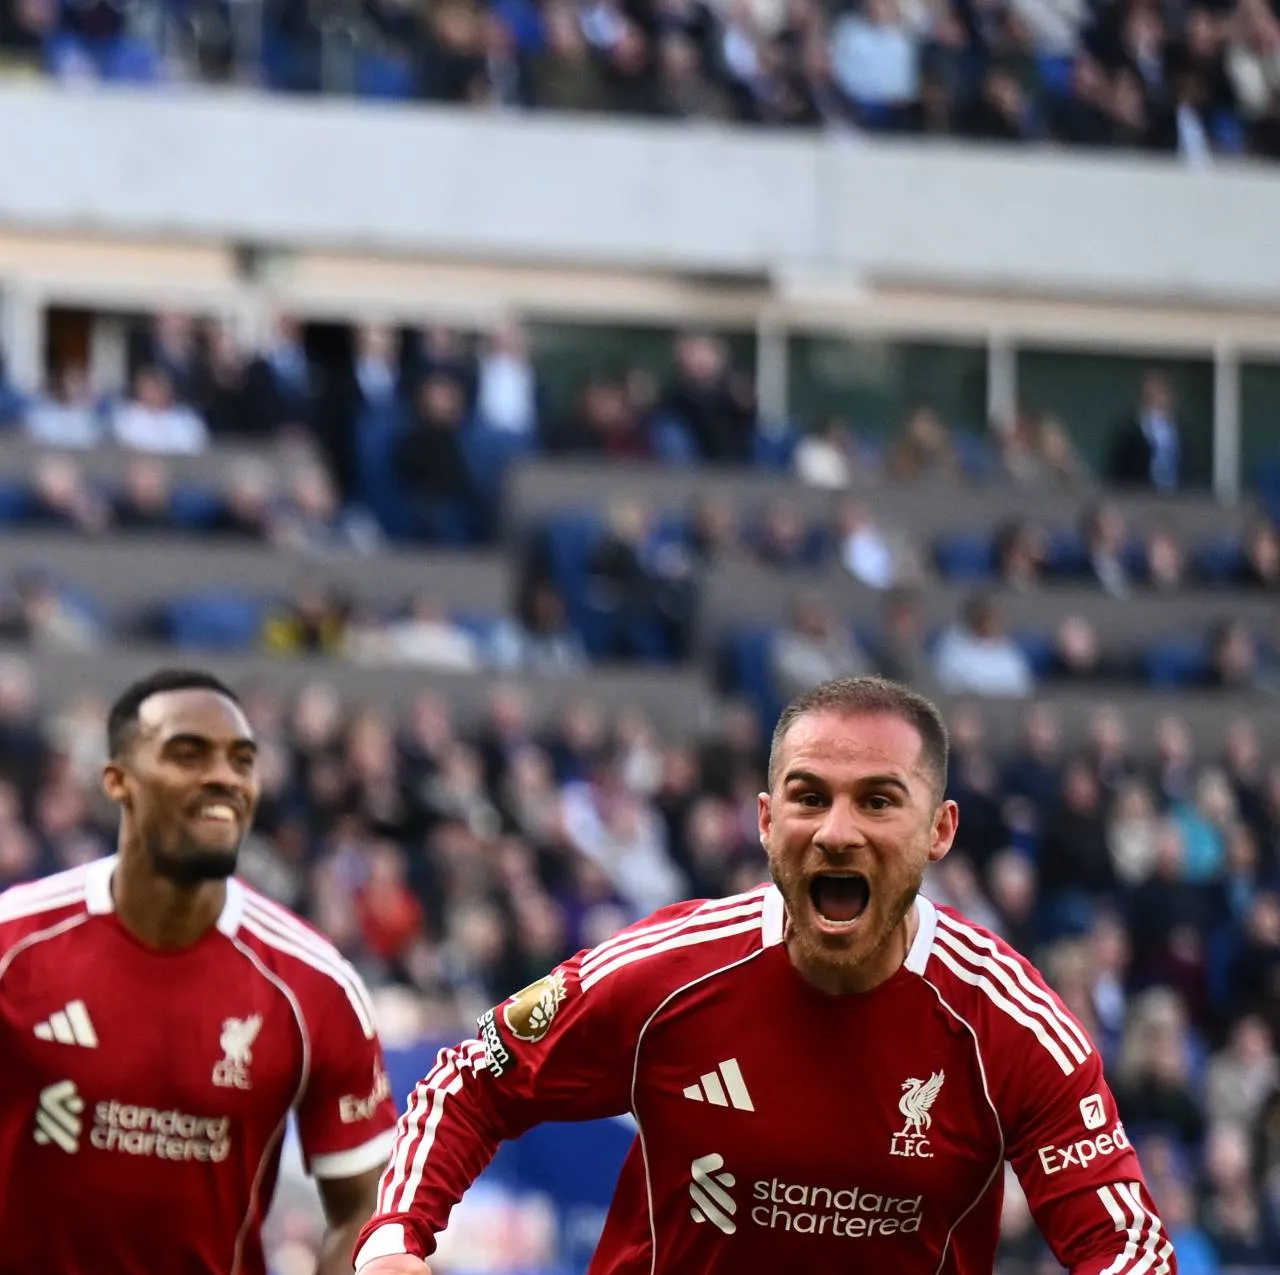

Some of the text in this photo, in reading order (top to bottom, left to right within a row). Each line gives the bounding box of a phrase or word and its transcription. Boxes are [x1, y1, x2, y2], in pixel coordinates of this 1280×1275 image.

[486, 1020, 509, 1065] room
[94, 1100, 231, 1142] standard
[90, 1126, 231, 1162] chartered
[752, 1177, 923, 1214] standard
[751, 1204, 923, 1238] chartered
